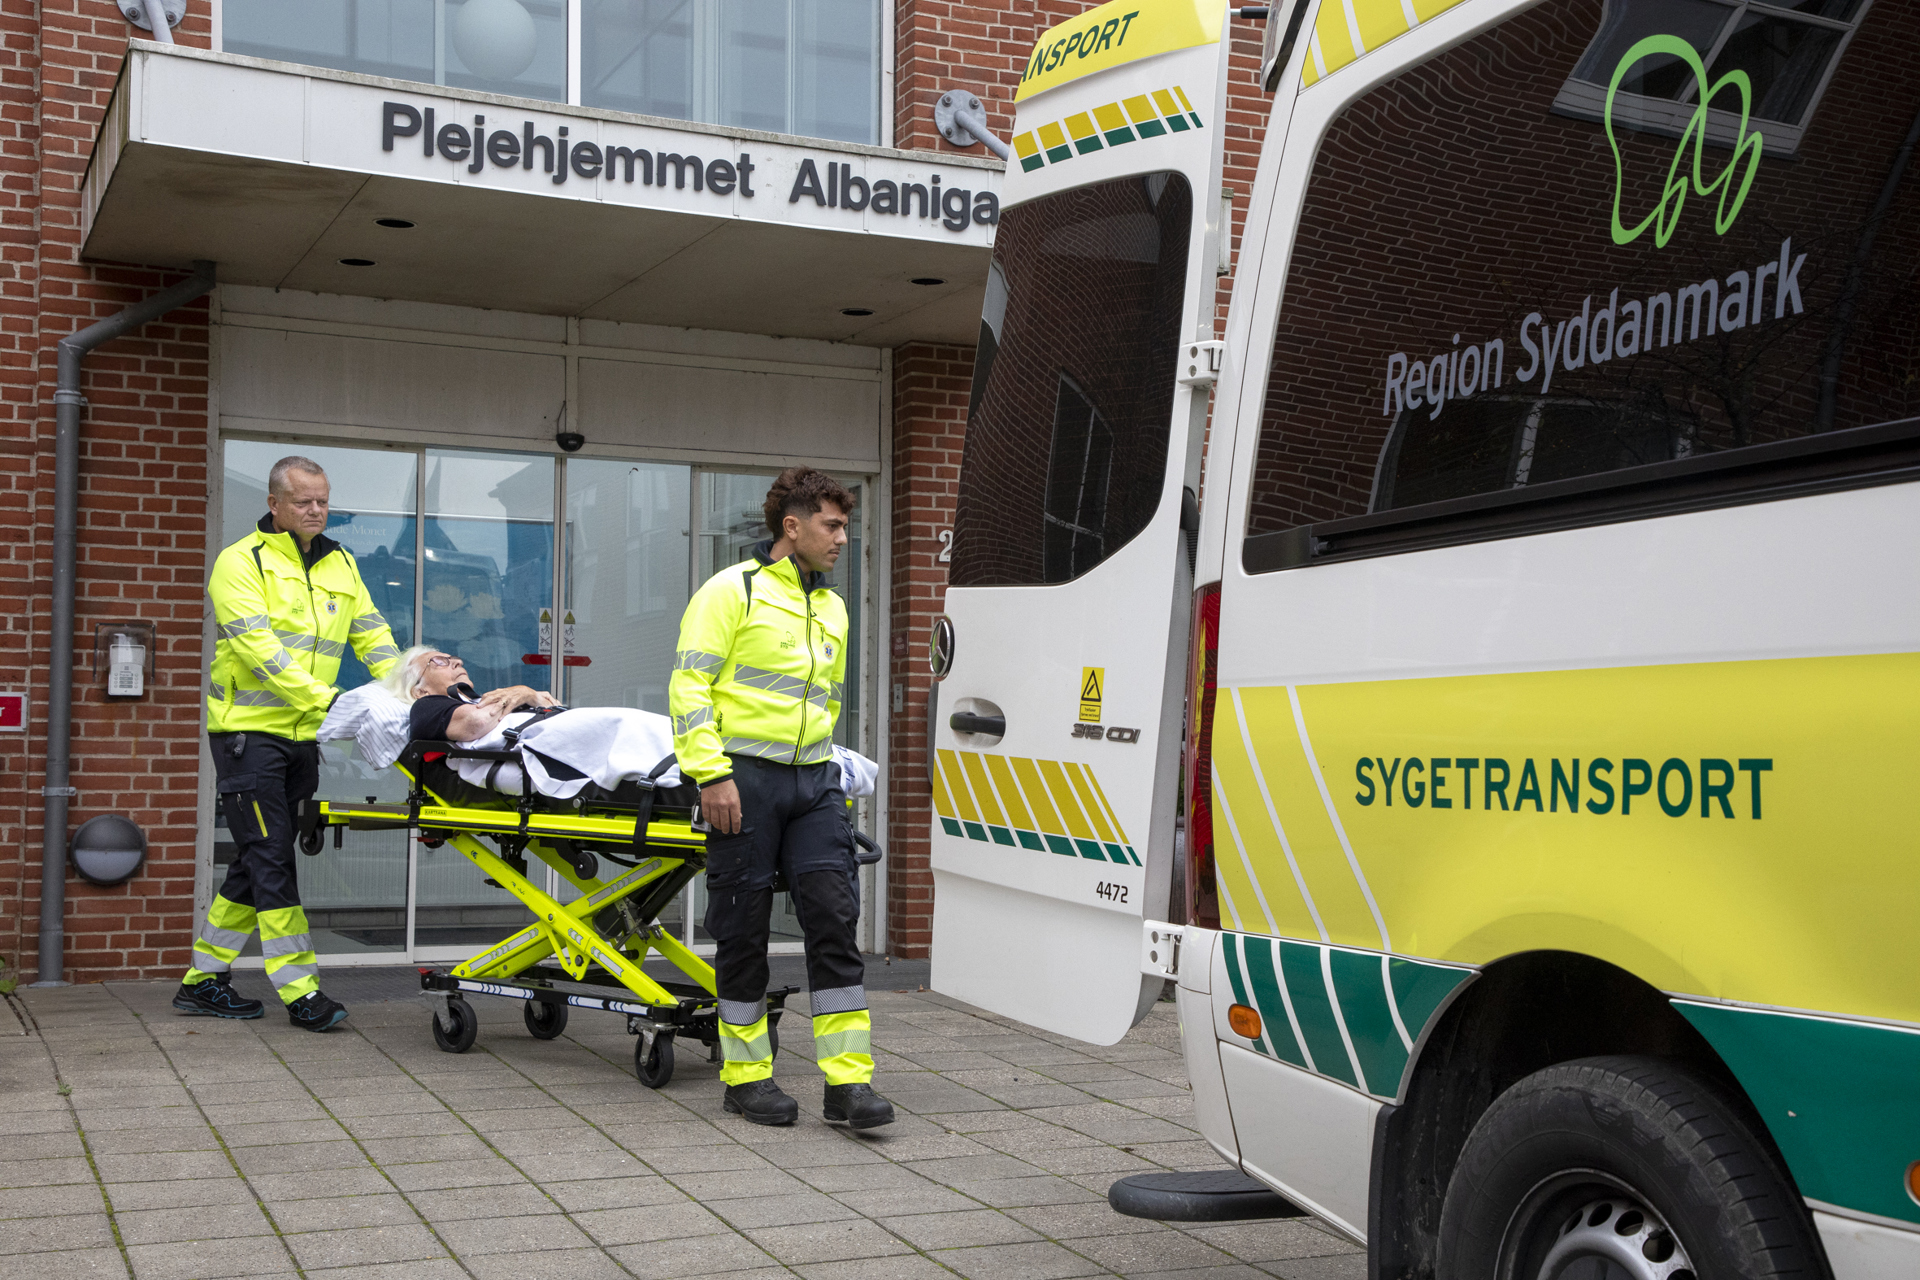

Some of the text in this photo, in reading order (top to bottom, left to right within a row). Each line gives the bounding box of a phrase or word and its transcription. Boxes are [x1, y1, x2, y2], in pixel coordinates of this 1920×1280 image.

[383, 101, 999, 232] Plejehjemmet Albaniga
[1383, 236, 1808, 421] Region Syddanmark
[352, 525, 386, 536] Monet
[938, 530, 953, 562] 2
[1106, 726, 1141, 744] CDI
[1355, 757, 1773, 820] SYGETRANSPORT
[1096, 881, 1128, 904] 4472
